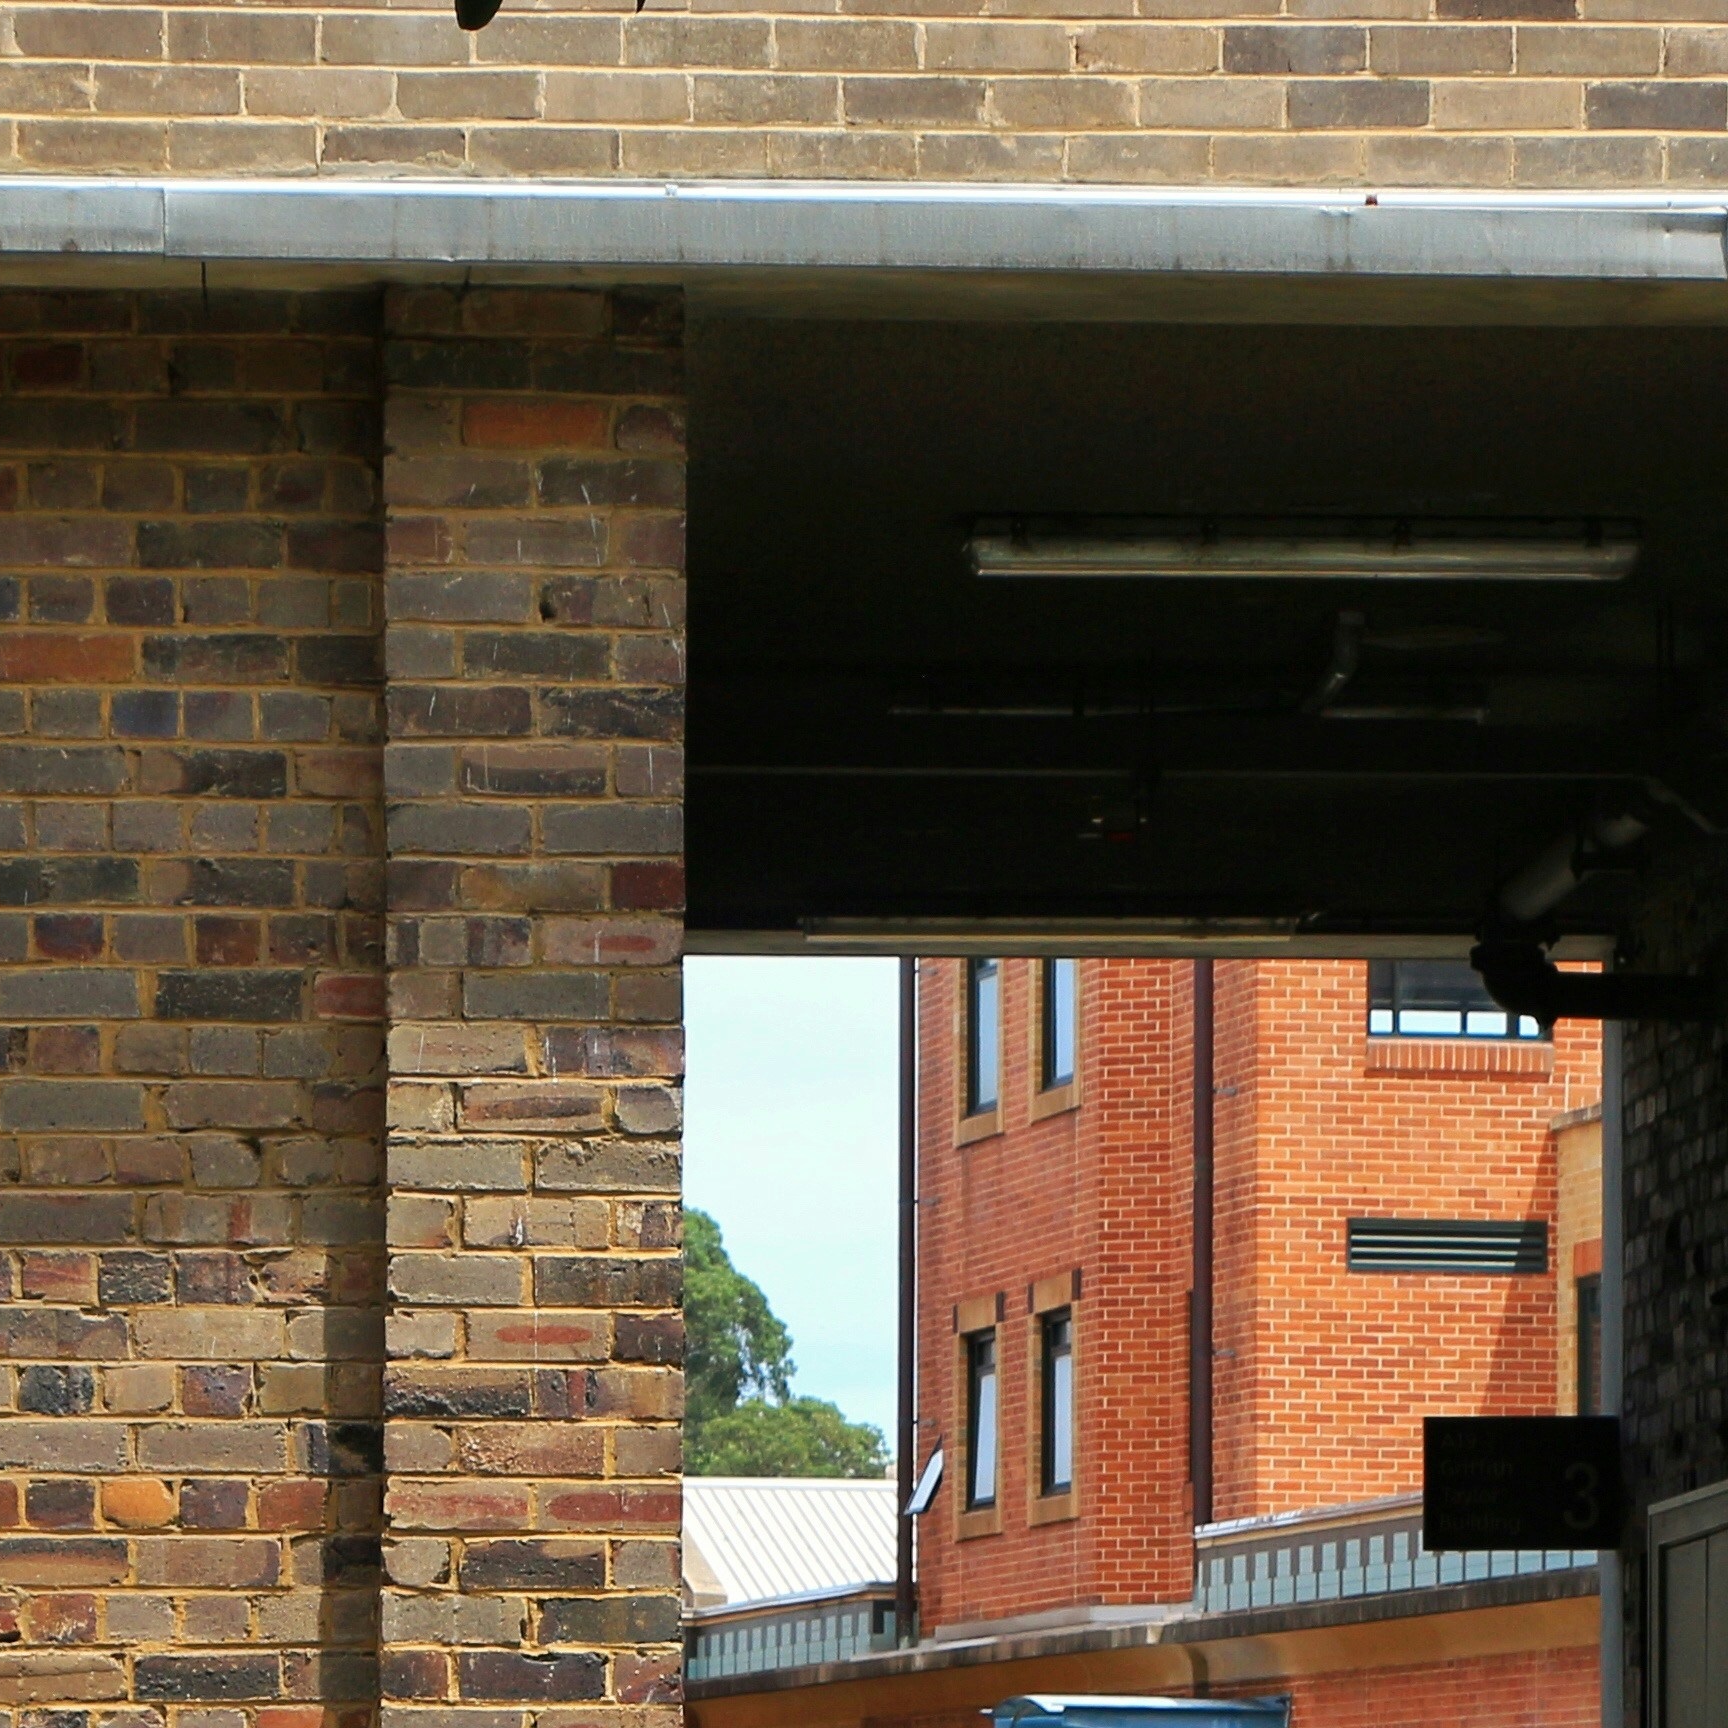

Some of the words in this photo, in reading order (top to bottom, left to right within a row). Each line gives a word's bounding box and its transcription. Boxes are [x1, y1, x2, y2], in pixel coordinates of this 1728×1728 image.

[1440, 1457, 1513, 1476] Griffith
[1564, 1463, 1600, 1530] 3
[1440, 1513, 1521, 1536] Building
